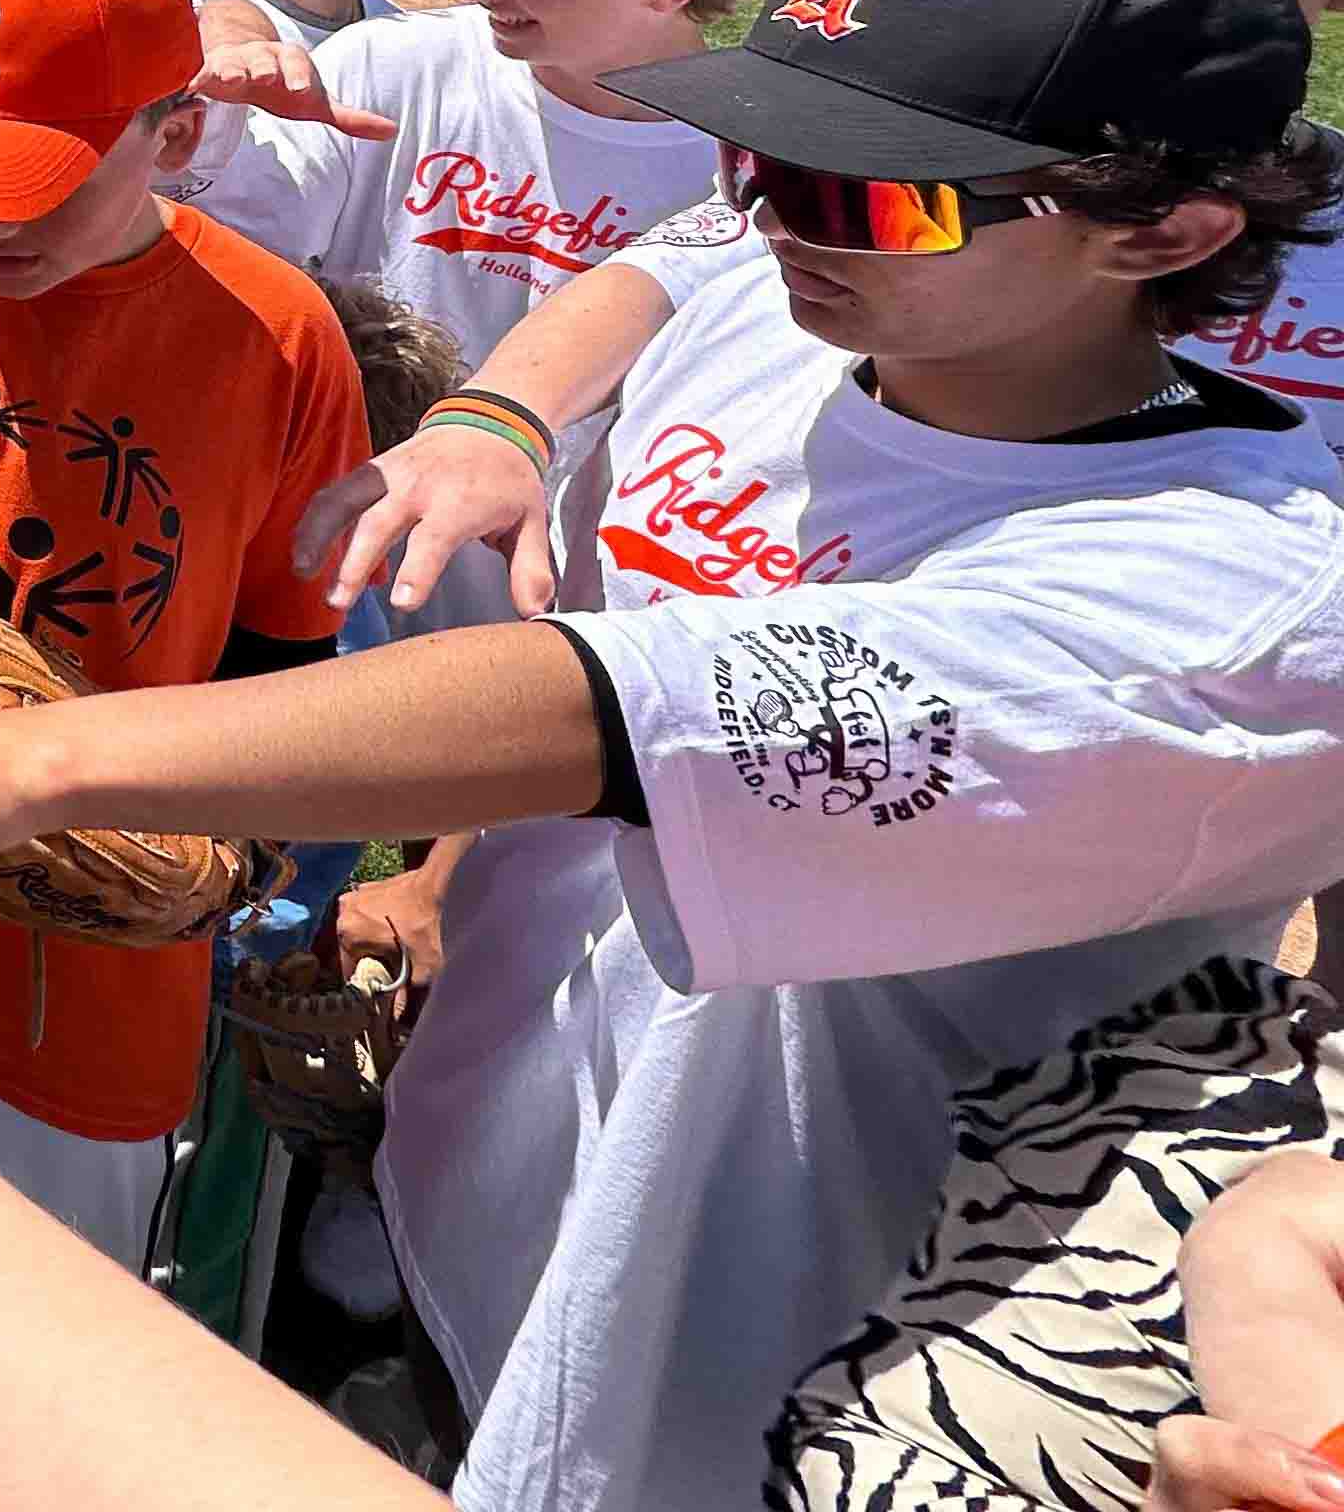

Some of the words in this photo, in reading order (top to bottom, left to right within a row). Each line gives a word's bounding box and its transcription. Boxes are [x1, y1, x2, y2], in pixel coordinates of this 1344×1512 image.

[477, 256, 551, 296] Holland
[617, 423, 853, 597] Ridgefi
[765, 623, 915, 692] CUSTOM
[869, 763, 955, 827] MORE
